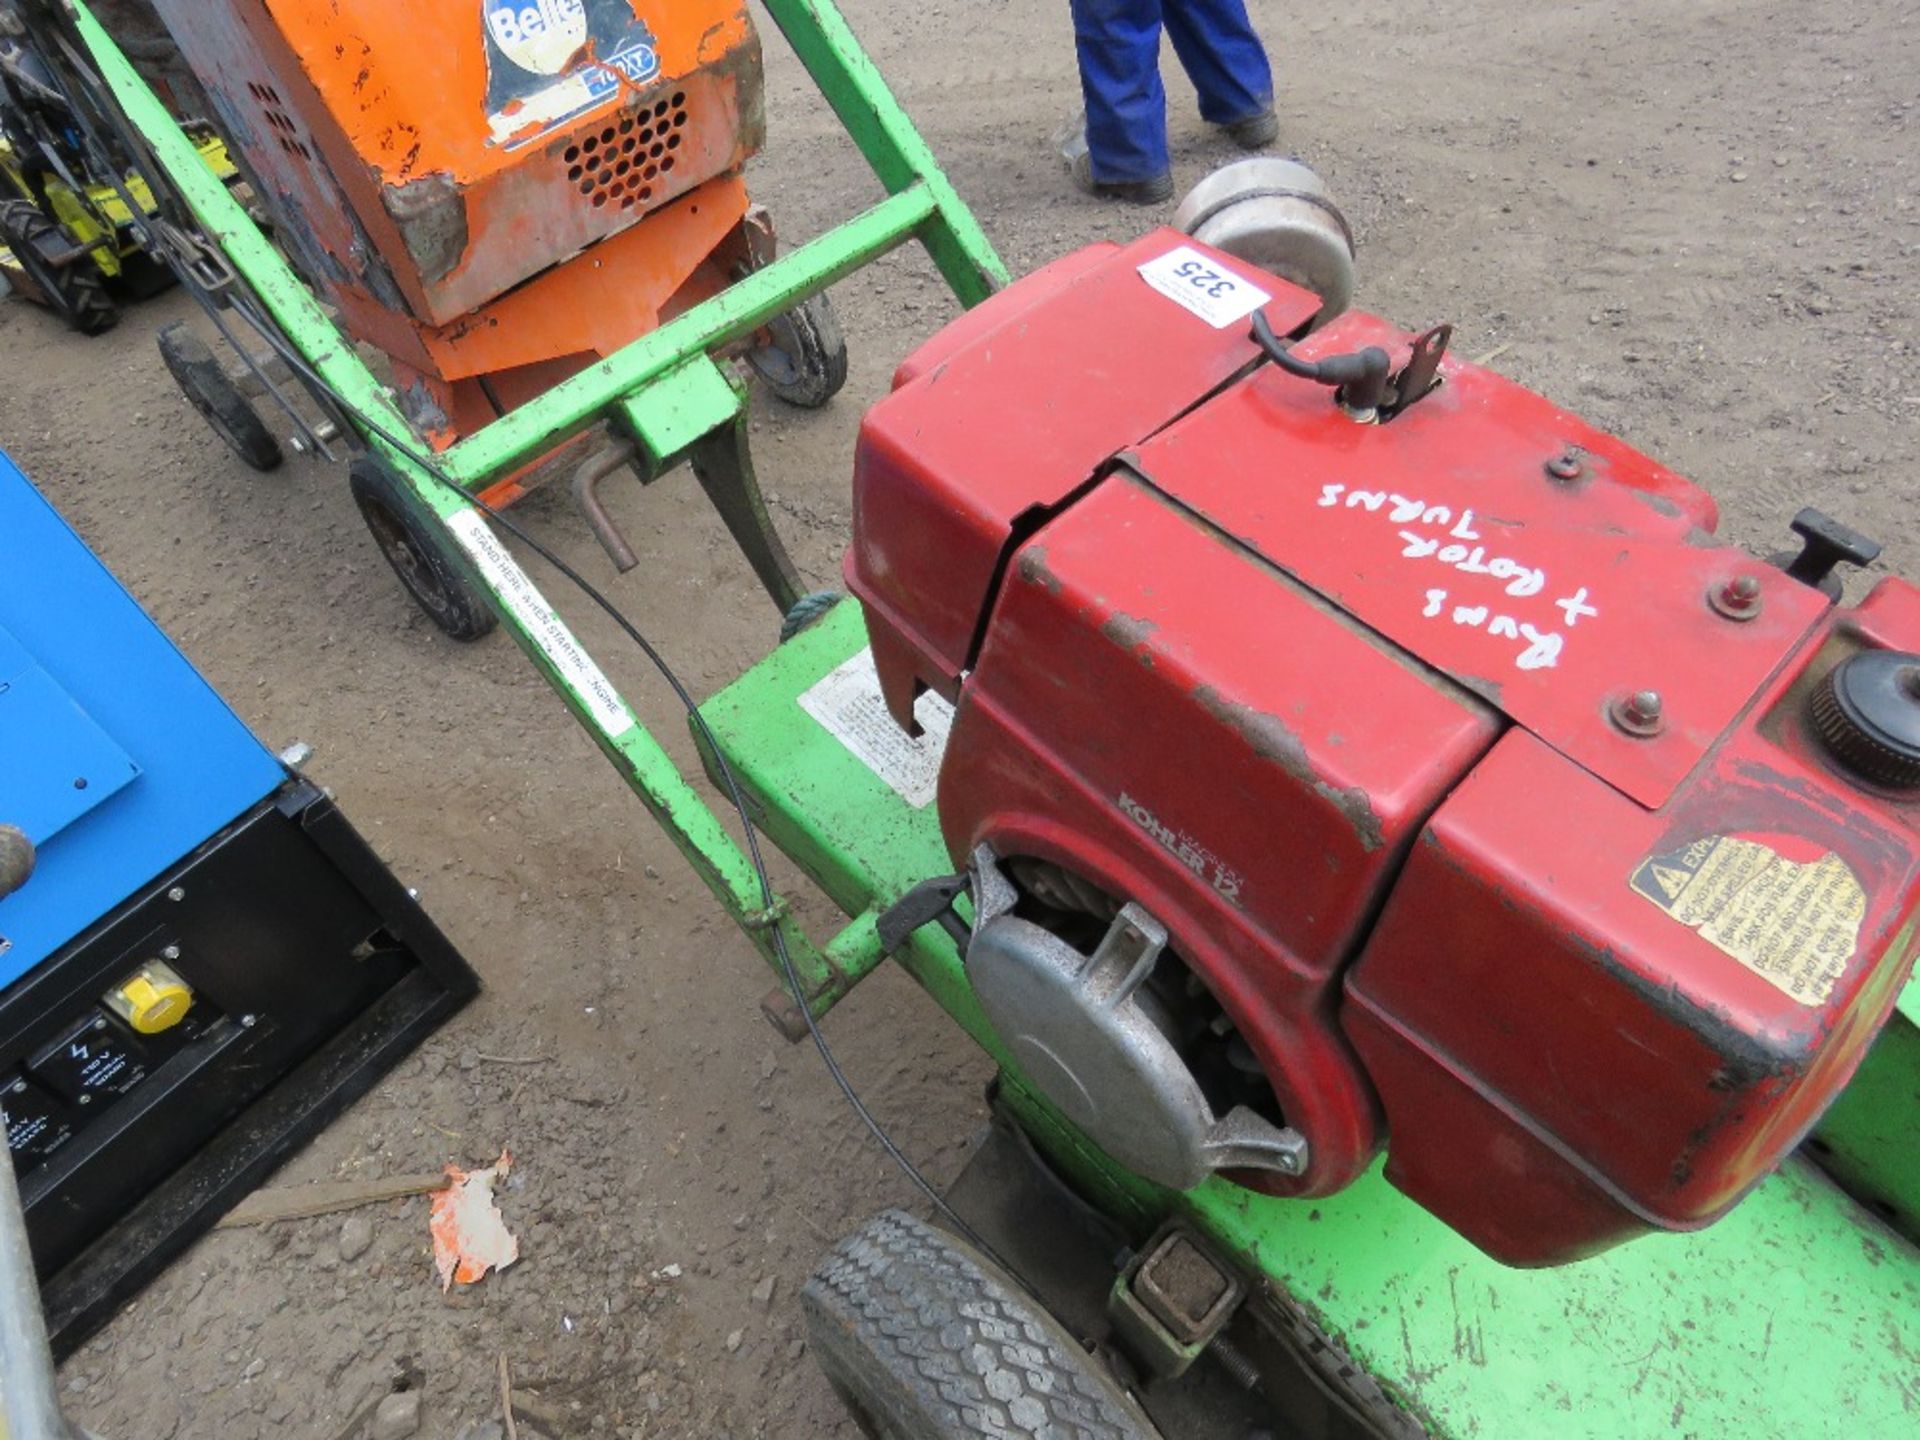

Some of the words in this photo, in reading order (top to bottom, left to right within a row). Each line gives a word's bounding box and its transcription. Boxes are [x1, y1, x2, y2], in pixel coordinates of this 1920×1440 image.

[1172, 260, 1236, 299] 325
[1317, 483, 1480, 540] TURNS
[470, 527, 500, 566] STAND
[1398, 529, 1546, 598] ROTOR
[1118, 791, 1206, 877] KOHLER
[1213, 866, 1240, 904] 12
[1770, 881, 1794, 902] FUEL
[1753, 950, 1769, 970] DO
[1764, 931, 1783, 953] NOT
[1790, 976, 1806, 994] DO
